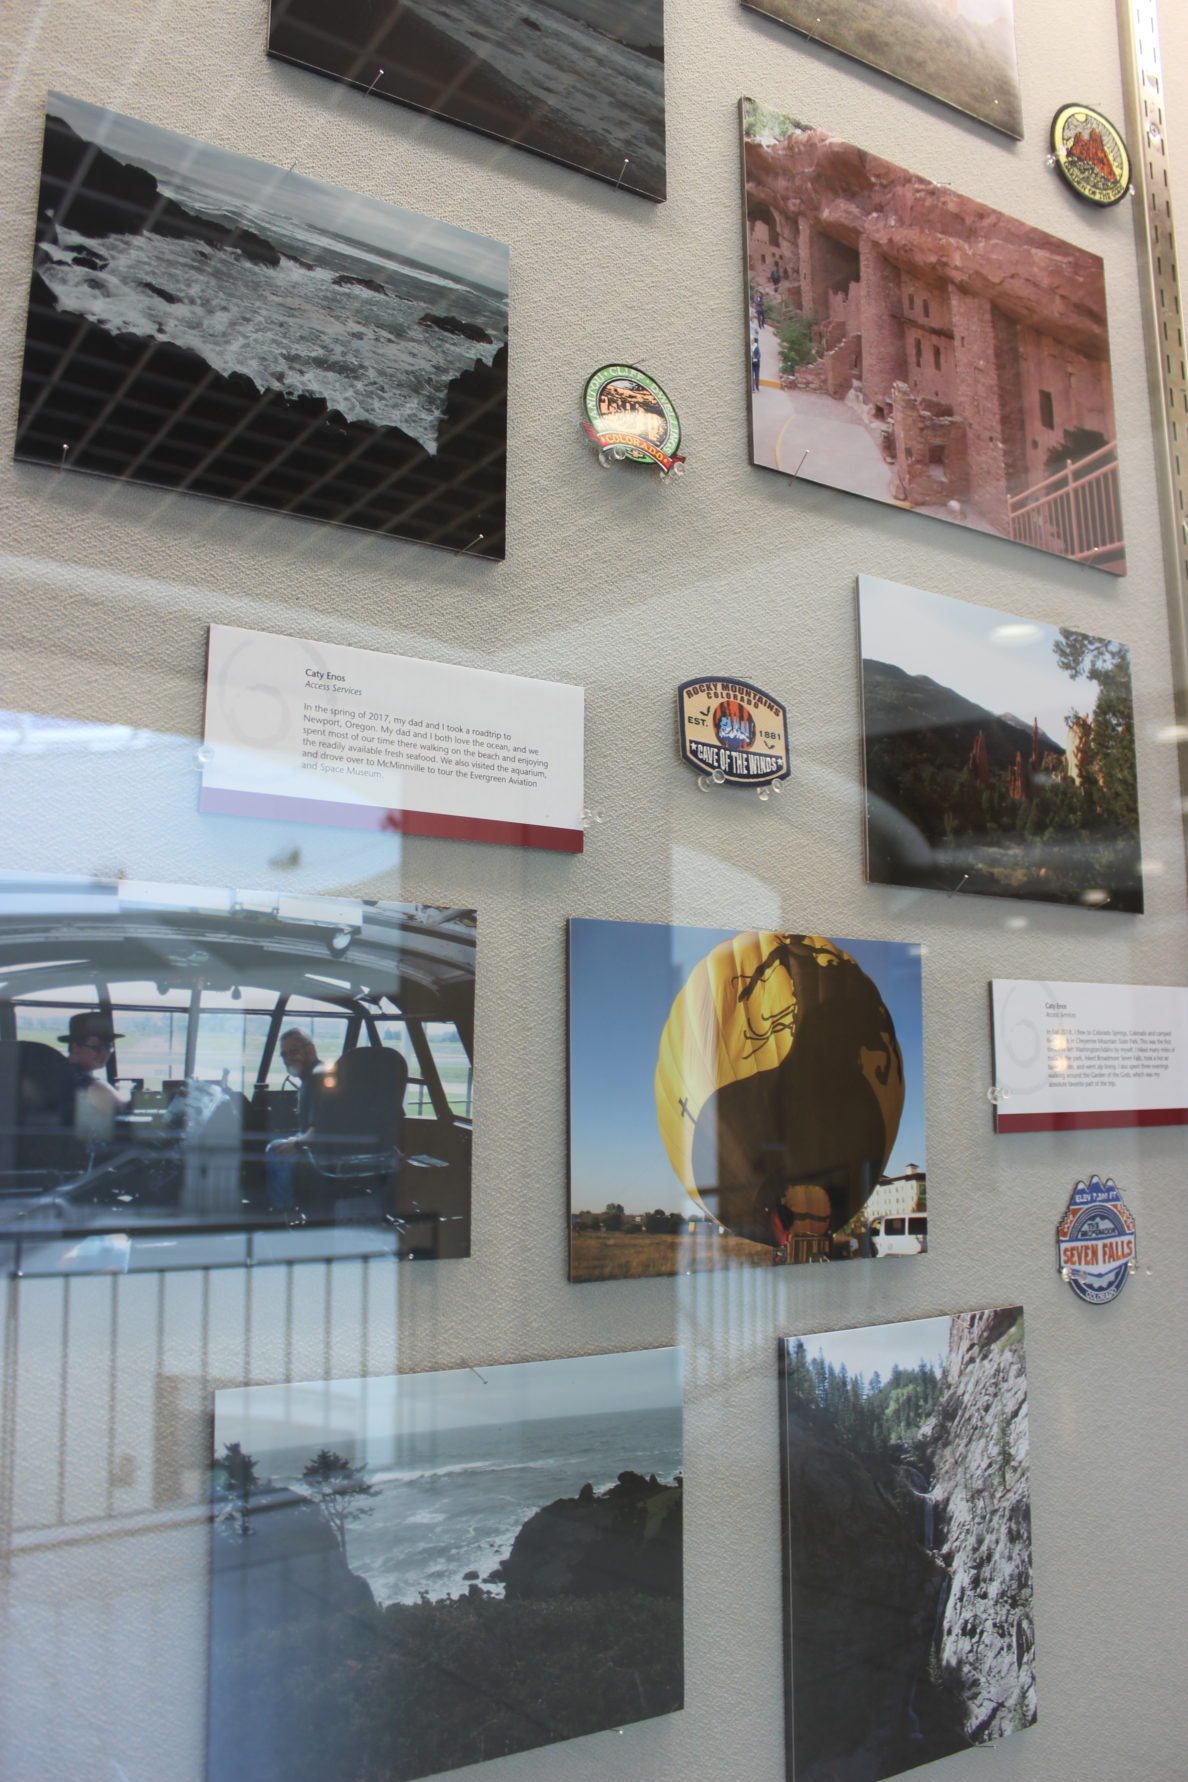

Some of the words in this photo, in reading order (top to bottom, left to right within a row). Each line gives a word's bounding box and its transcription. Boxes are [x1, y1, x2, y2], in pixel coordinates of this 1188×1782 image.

[609, 367, 644, 380] CLIFF
[606, 435, 663, 460] COLORADO
[305, 668, 324, 681] Caty
[326, 672, 346, 682] Enos
[305, 680, 330, 691] Access
[332, 684, 362, 696] Services
[685, 682, 718, 699] ROCKY
[721, 683, 781, 717] MOUNTAINS
[706, 691, 760, 710] COLORADO
[304, 703, 312, 711] In
[315, 704, 328, 713] the
[330, 708, 356, 720] spring
[358, 711, 367, 719] of
[368, 712, 391, 724] 2017,
[393, 717, 406, 727] my
[408, 718, 423, 728] dad
[425, 721, 440, 730] and
[446, 724, 464, 734] took
[472, 728, 502, 740] roadtrip
[503, 733, 512, 741] to
[687, 715, 709, 728] EST.
[303, 715, 342, 728] Newport,
[345, 720, 378, 733] Oregon.
[380, 725, 394, 736] My
[395, 727, 411, 737] dad
[413, 729, 428, 739] and
[435, 733, 453, 743] both
[454, 736, 471, 746] love
[472, 739, 485, 748] the
[486, 742, 510, 752] ocean,
[512, 745, 527, 754] and
[528, 748, 540, 756] we
[759, 730, 781, 741] 1881
[302, 738, 316, 747] the
[318, 741, 346, 753] readily
[348, 745, 383, 756] available
[384, 748, 404, 759] fresh
[406, 751, 438, 763] seafood.
[440, 756, 453, 766] We
[454, 758, 470, 768] also
[471, 760, 495, 771] visited
[496, 764, 509, 773] the
[510, 767, 547, 779] aquarium,
[303, 727, 326, 737] spent
[328, 731, 349, 741] most
[351, 732, 360, 741] of
[361, 735, 375, 744] our
[377, 737, 395, 746] time
[397, 739, 418, 750] there
[420, 743, 449, 756] walking
[463, 748, 476, 757] the
[478, 750, 500, 760] beach
[502, 754, 516, 763] and
[517, 757, 549, 770] enjoying
[697, 744, 719, 767] CAVE
[719, 748, 731, 772] OF
[731, 751, 748, 775] THE
[748, 754, 777, 775] WINDS
[301, 761, 318, 770] and
[320, 763, 345, 774] Space
[347, 766, 384, 779] Museum.
[302, 750, 318, 759] and
[320, 751, 344, 762] drove
[346, 755, 364, 764] over
[366, 757, 375, 766] to
[376, 759, 425, 773] McMinnville
[427, 766, 436, 774] to
[437, 768, 453, 776] tour
[455, 769, 469, 778] the
[469, 771, 507, 784] Evergreen
[508, 777, 538, 788] Aviation
[1063, 1243, 1099, 1266] SEVEN
[1102, 1240, 1133, 1264] FALLS
